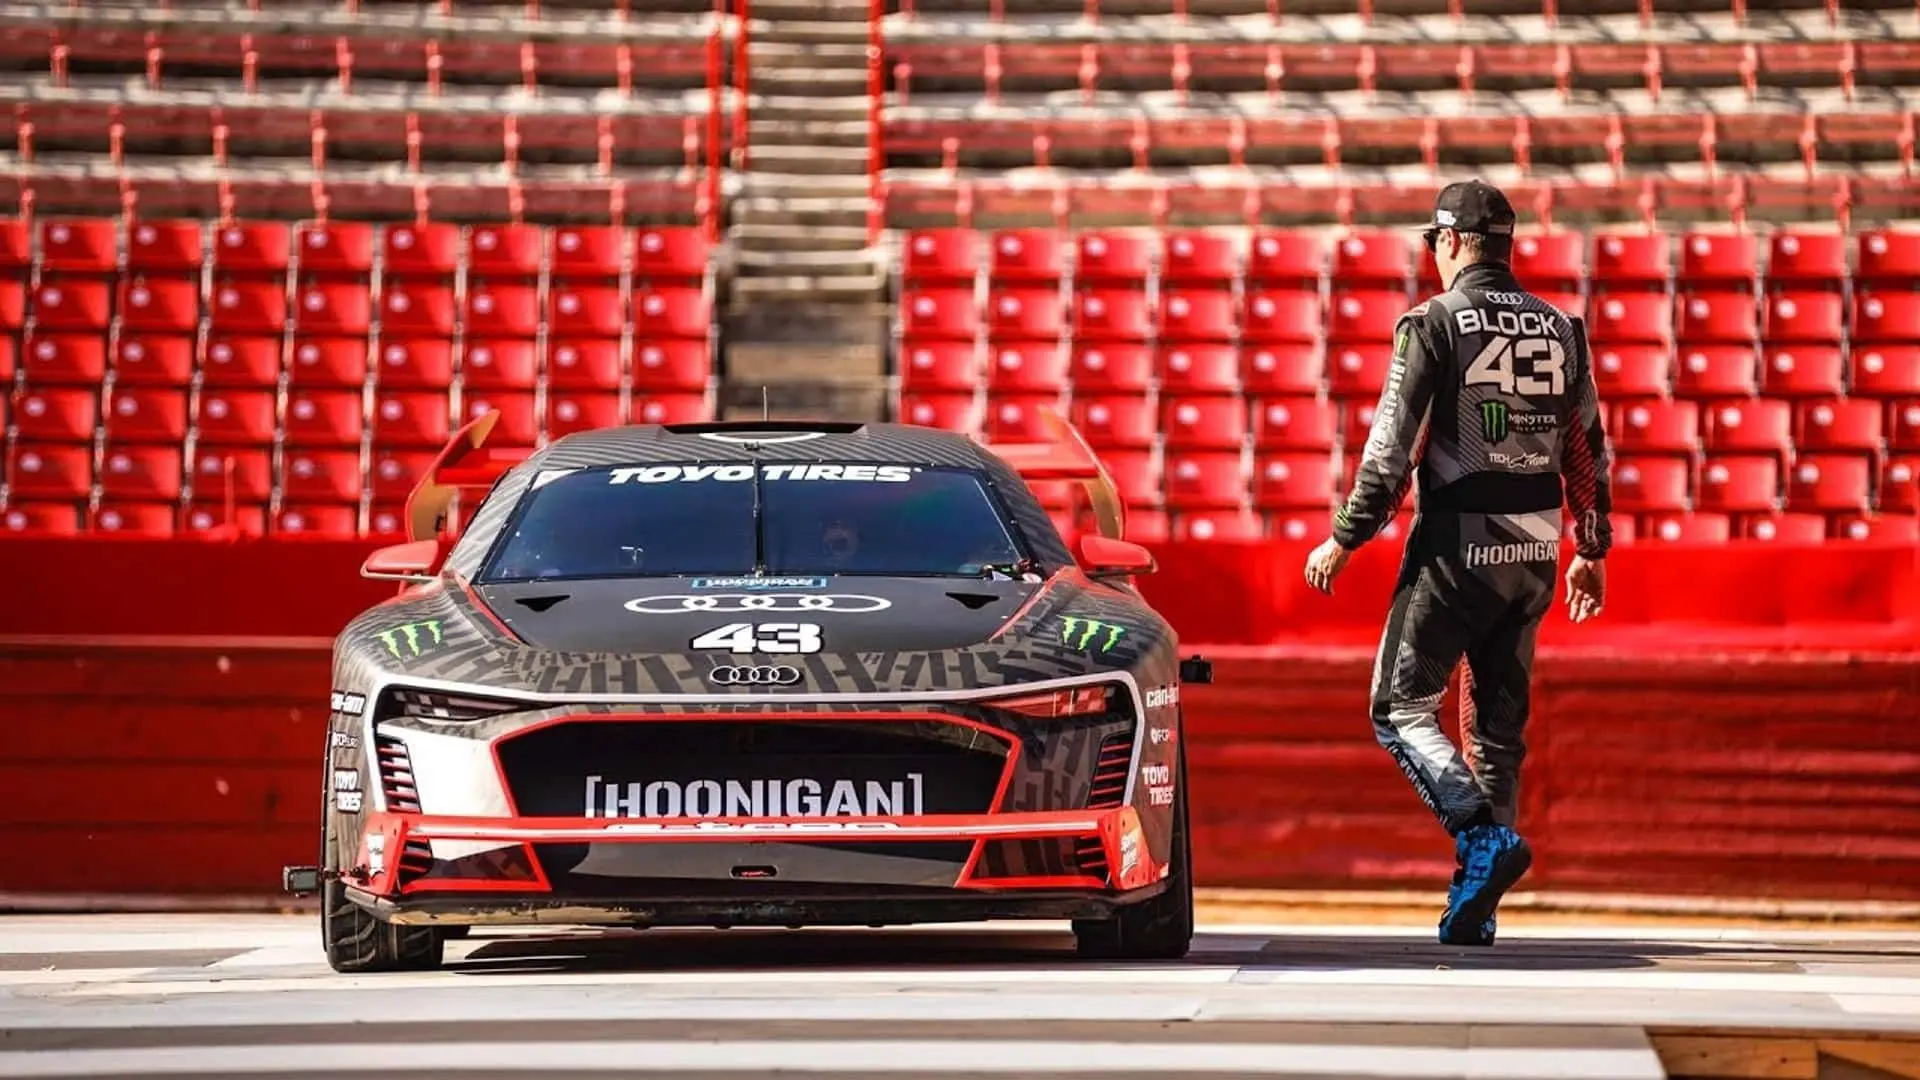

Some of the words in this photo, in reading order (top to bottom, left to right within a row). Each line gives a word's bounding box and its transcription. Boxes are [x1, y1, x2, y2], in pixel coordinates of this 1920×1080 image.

[1455, 308, 1560, 338] BLOCK
[1464, 335, 1566, 396] 43
[1489, 452, 1510, 465] TECH
[609, 465, 756, 485] TOYO
[762, 464, 913, 483] TIRES
[691, 622, 823, 654] 43
[1142, 765, 1169, 786] TOYO
[1149, 786, 1175, 806] TIRES
